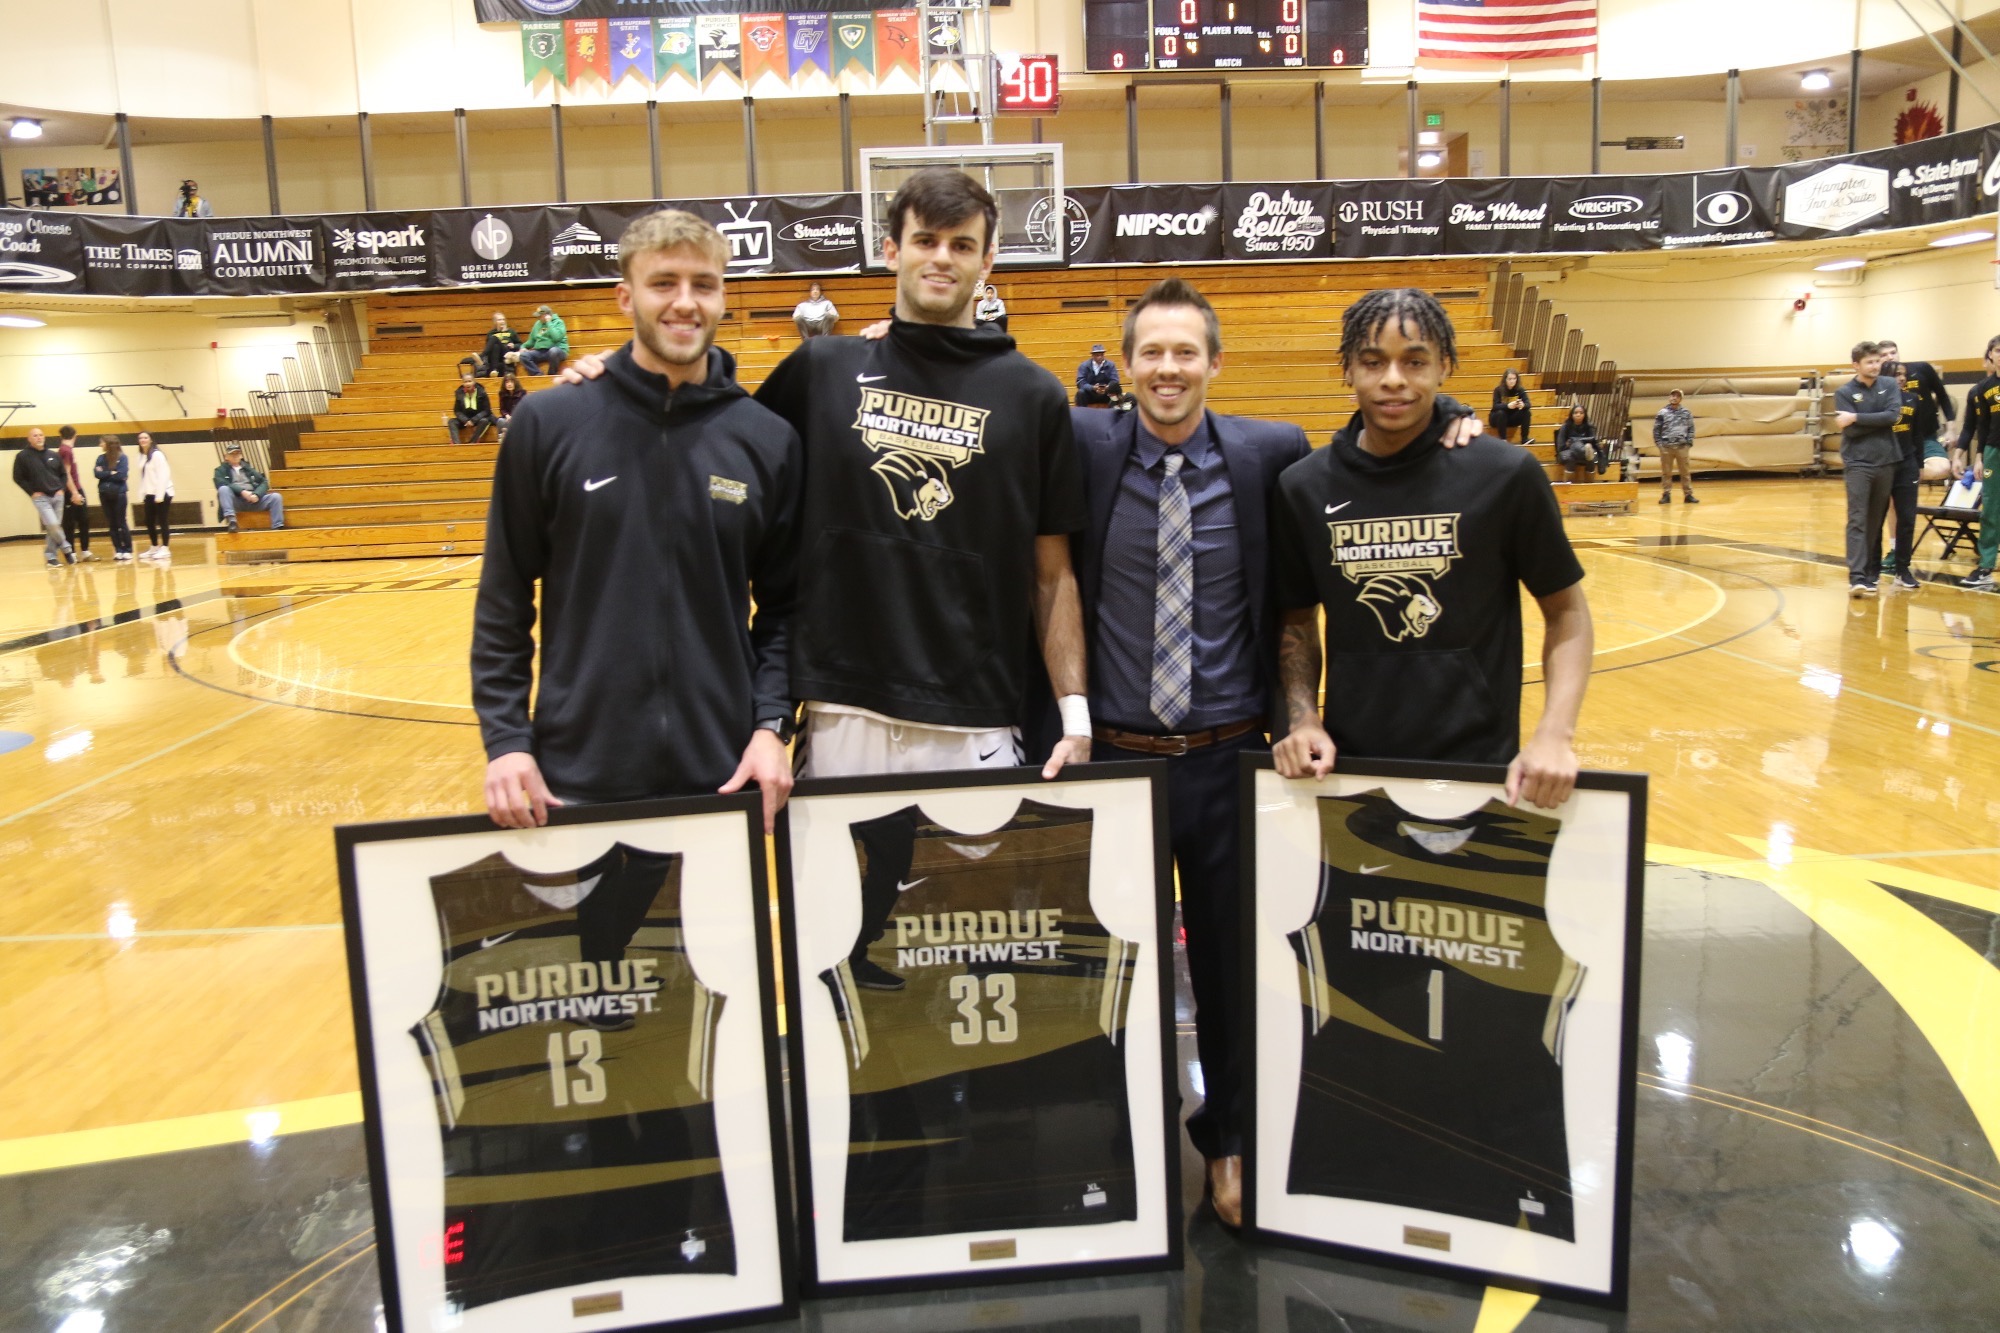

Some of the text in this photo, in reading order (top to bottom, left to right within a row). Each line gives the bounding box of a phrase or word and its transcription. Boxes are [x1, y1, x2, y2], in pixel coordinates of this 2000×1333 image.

[1181, 0, 1196, 23] 0
[1283, 0, 1298, 22] 0
[523, 22, 560, 31] PARKSIDE
[575, 27, 599, 35] STATE
[1155, 27, 1180, 36] FOULS
[1202, 26, 1254, 35] PLAYER FOUL
[1276, 25, 1301, 34] FOULS
[1164, 36, 1177, 55] 0
[1285, 34, 1298, 54] 0
[705, 50, 737, 59] PRIDE
[1159, 59, 1178, 68] WON
[1215, 58, 1242, 67] MATCH
[1284, 57, 1303, 66] WON
[1913, 158, 1979, 185] State Farm
[1808, 178, 1868, 199] Hampton
[1243, 191, 1314, 223] Dairy
[1361, 200, 1424, 221] RUSH
[1800, 199, 1829, 213] Inn
[1845, 192, 1877, 206] Suites
[1449, 202, 1548, 225] The Wheel
[26, 218, 72, 235] Classic
[794, 224, 829, 239] Strack
[1116, 212, 1205, 237] NIPSCO
[1233, 214, 1300, 239] Belle
[1361, 225, 1440, 237] Physical Therapy
[1465, 222, 1542, 231] FAMILY RESTAURANT
[1554, 220, 1659, 232] Painting & Decorating LLC
[212, 229, 313, 241] PURDUE NORTHWEST
[357, 225, 425, 254] spark
[727, 232, 764, 256] TV
[1245, 236, 1315, 252] Since 1950
[1664, 230, 1774, 245] BenaventeEyecare.com
[0, 237, 41, 253] Coach
[84, 243, 173, 261] THE TIMES
[213, 240, 313, 264] ALUMNI
[553, 243, 621, 256] PURDUE FE
[88, 261, 121, 269] MEDIA
[334, 255, 426, 266] PROMOTIONAL ITEMS
[461, 262, 528, 272] NORTH POINT
[215, 263, 313, 278] COMMUNITY
[462, 269, 529, 279] ORTHOPAEDICS
[863, 391, 982, 432] PURDUE
[860, 412, 979, 448] NORTHWEST
[879, 432, 954, 454] BASKETBALL
[1335, 517, 1453, 547] PURDUE
[1336, 540, 1453, 562] NORTHWEST
[1356, 559, 1433, 570] BASKETBALL
[895, 908, 1064, 947] PURDUE
[1351, 897, 1524, 949] PURDUE
[897, 940, 1061, 968] NORTHWEST
[1351, 930, 1523, 970] NORTHWEST
[475, 957, 661, 1009] PURDUE
[478, 992, 657, 1031] NORTHWEST
[949, 973, 1019, 1045] 33
[1427, 969, 1444, 1041] 1
[547, 1029, 607, 1108] 13
[1087, 1182, 1101, 1192] XL
